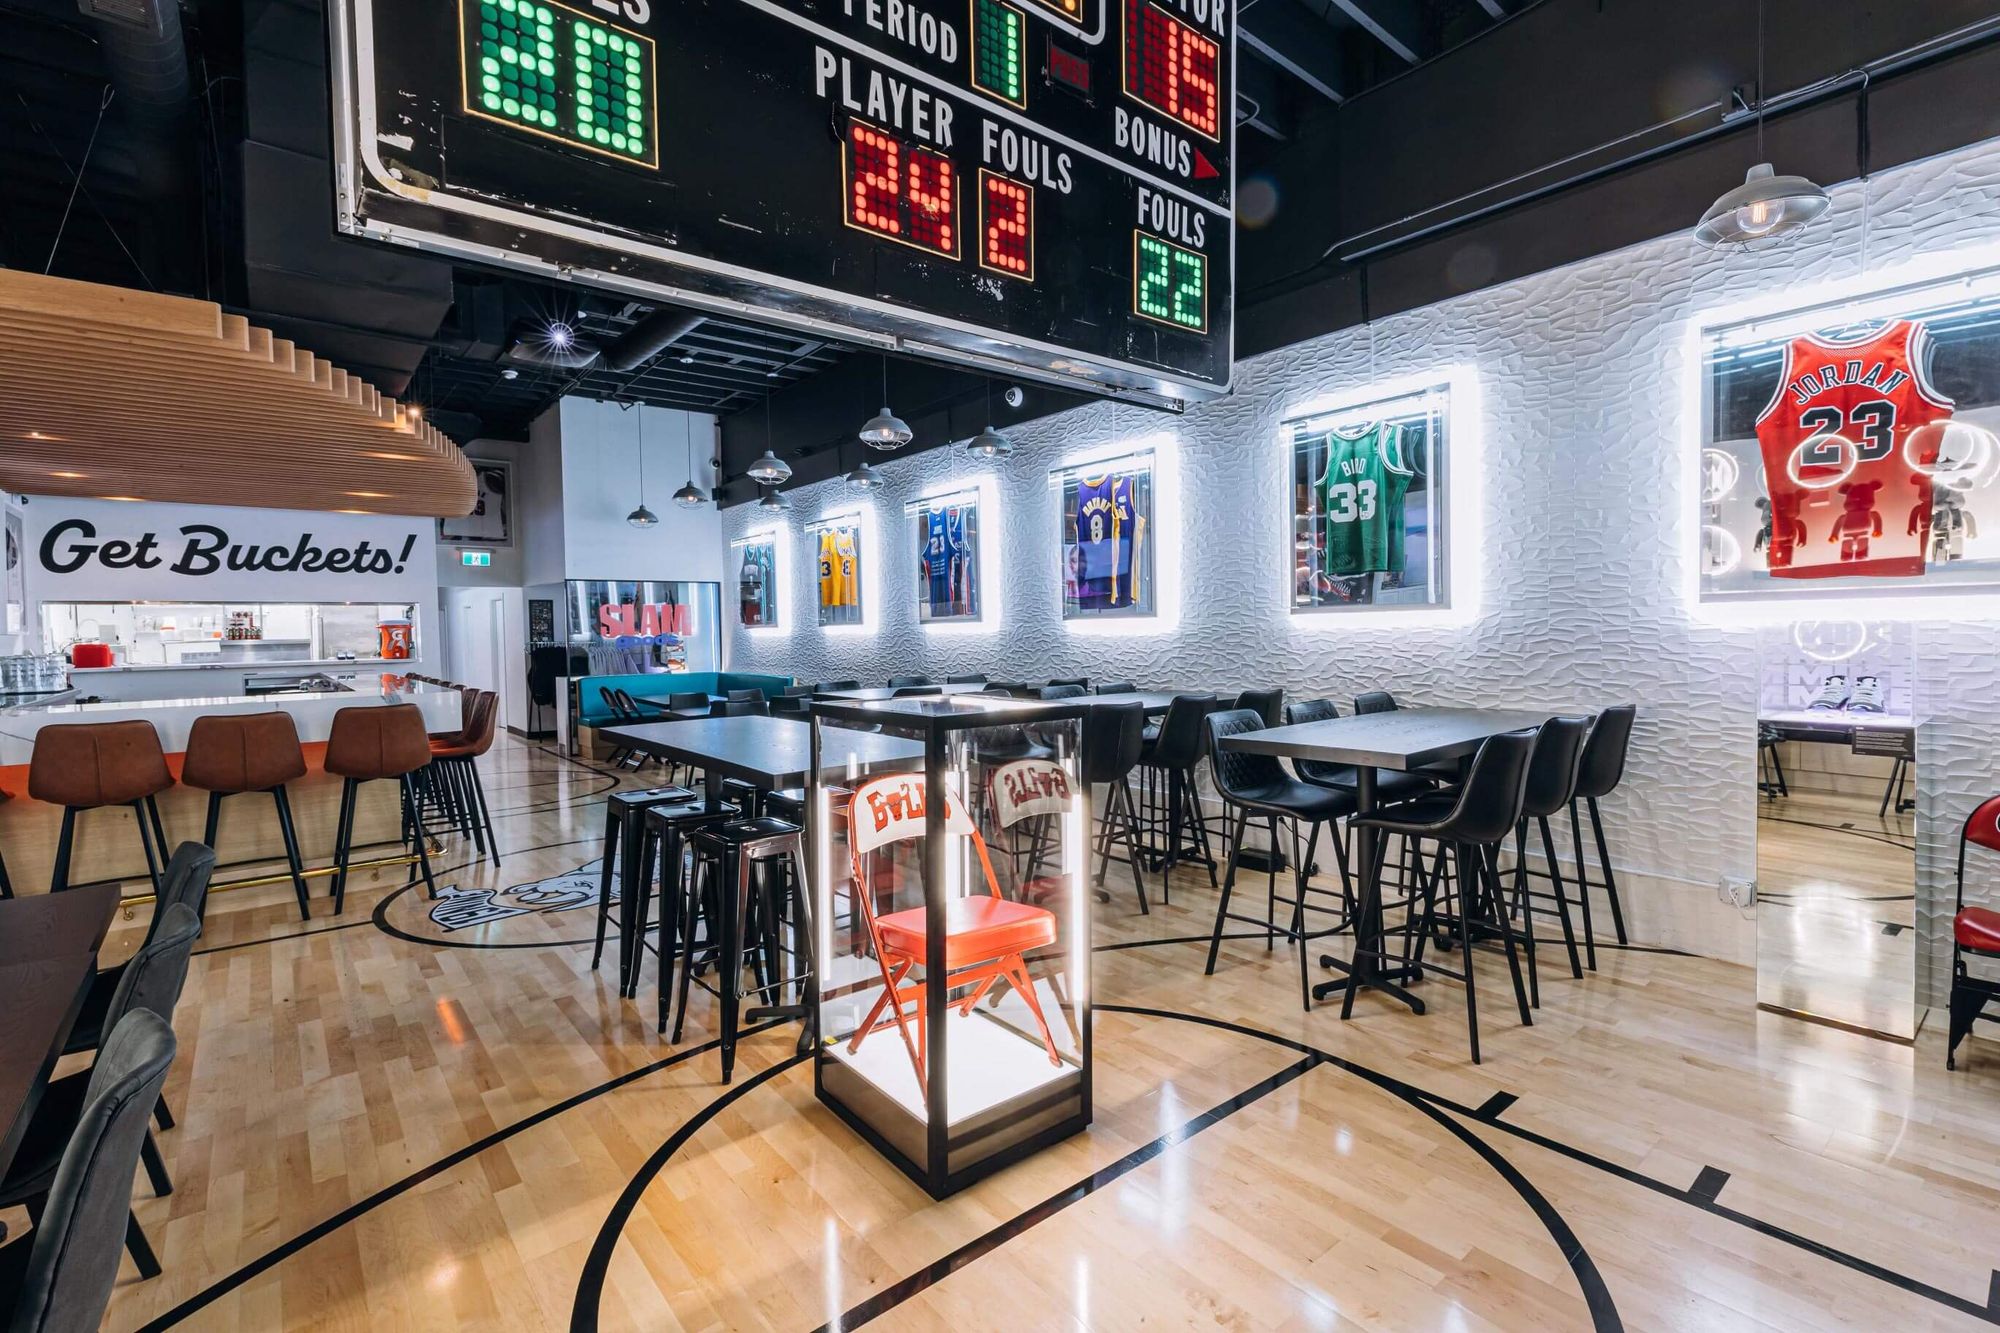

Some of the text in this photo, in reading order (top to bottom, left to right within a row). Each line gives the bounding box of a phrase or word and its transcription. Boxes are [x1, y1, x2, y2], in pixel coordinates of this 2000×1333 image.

[480, 0, 644, 154] 20
[1168, 21, 1215, 134] 15
[815, 45, 1072, 194] PLAYER FOULS
[1115, 106, 1191, 178] BONUS
[853, 126, 951, 251] 24
[1137, 187, 1205, 247] FOULS
[988, 178, 1026, 272] 2
[1141, 237, 1201, 326] 22
[1787, 360, 1908, 406] JORDAN
[1799, 399, 1897, 467] 23
[1090, 514, 1103, 545] 8
[1329, 479, 1377, 523] 33
[39, 518, 417, 576] Get Buckets!
[600, 603, 692, 638] SLAM
